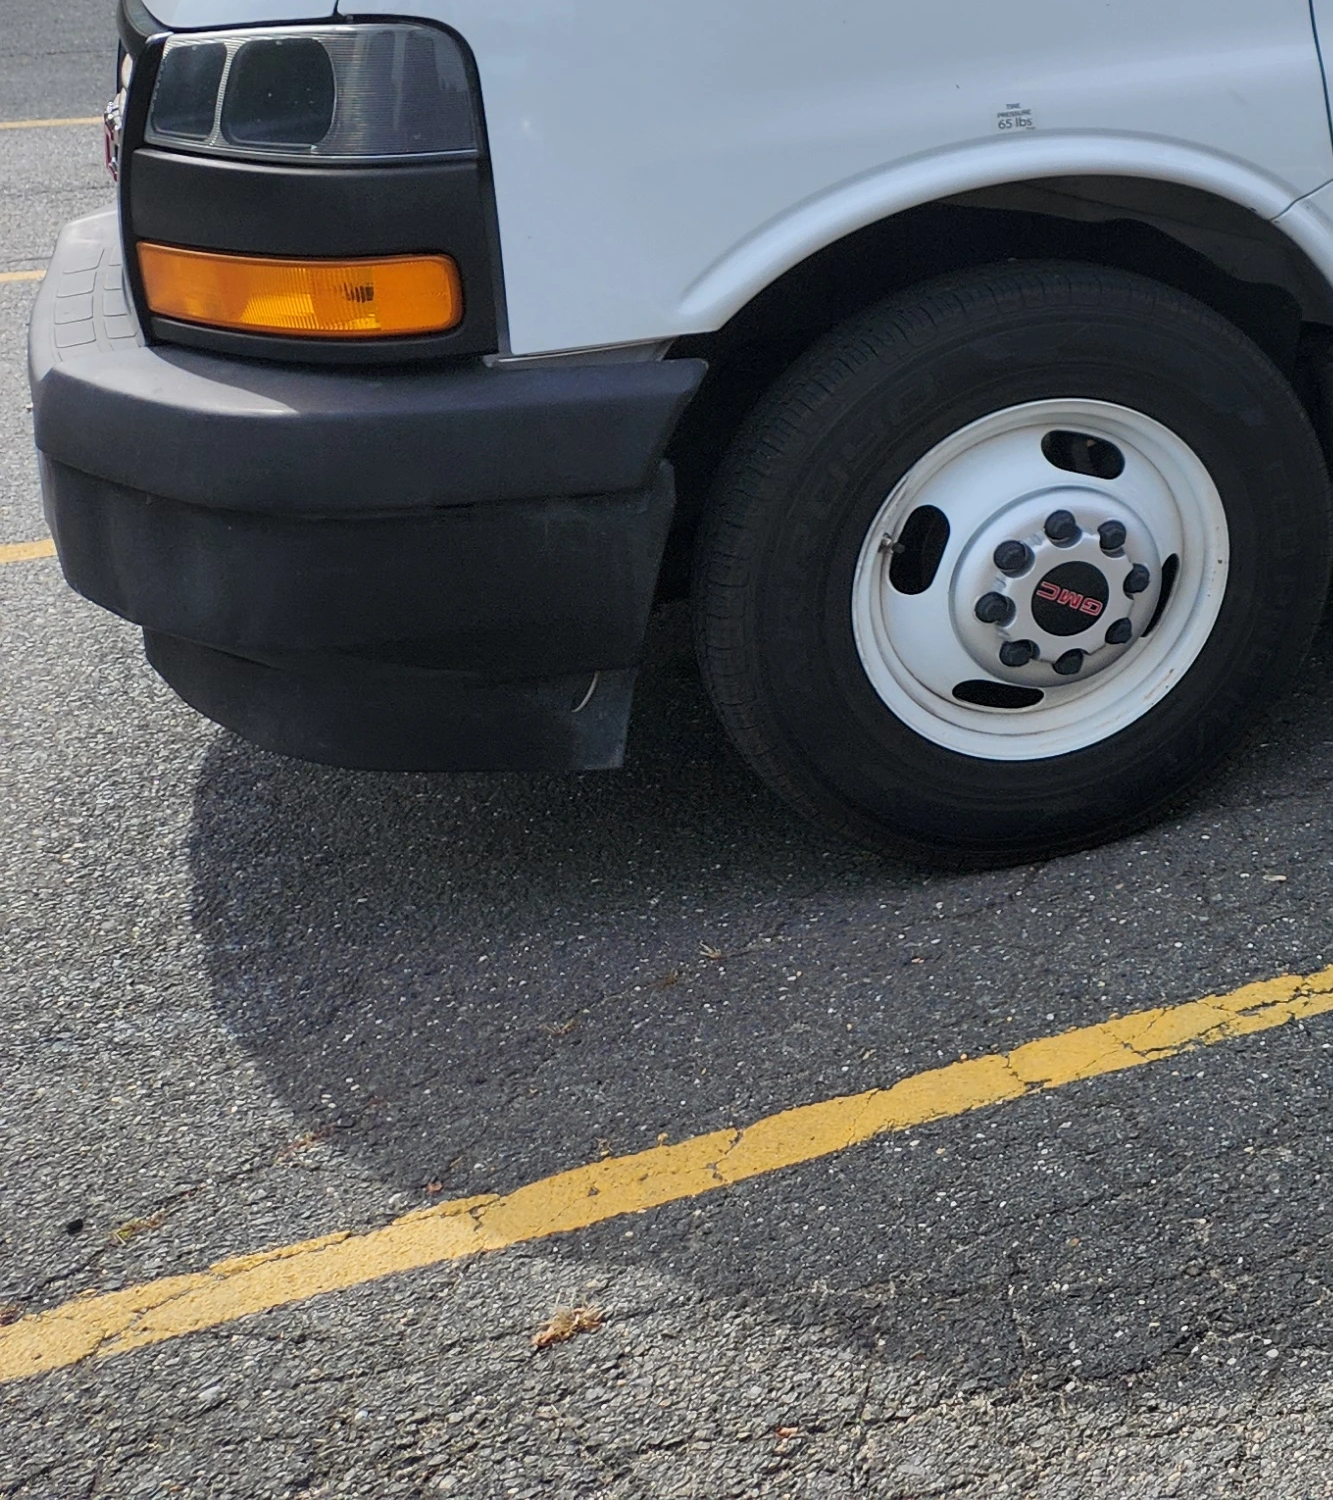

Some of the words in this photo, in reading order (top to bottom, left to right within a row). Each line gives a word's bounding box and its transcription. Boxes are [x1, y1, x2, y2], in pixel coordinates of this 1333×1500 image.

[997, 109, 1032, 119] PRESSURE
[998, 119, 1012, 130] 65
[1015, 117, 1033, 127] lbs
[1036, 581, 1103, 617] GMC
